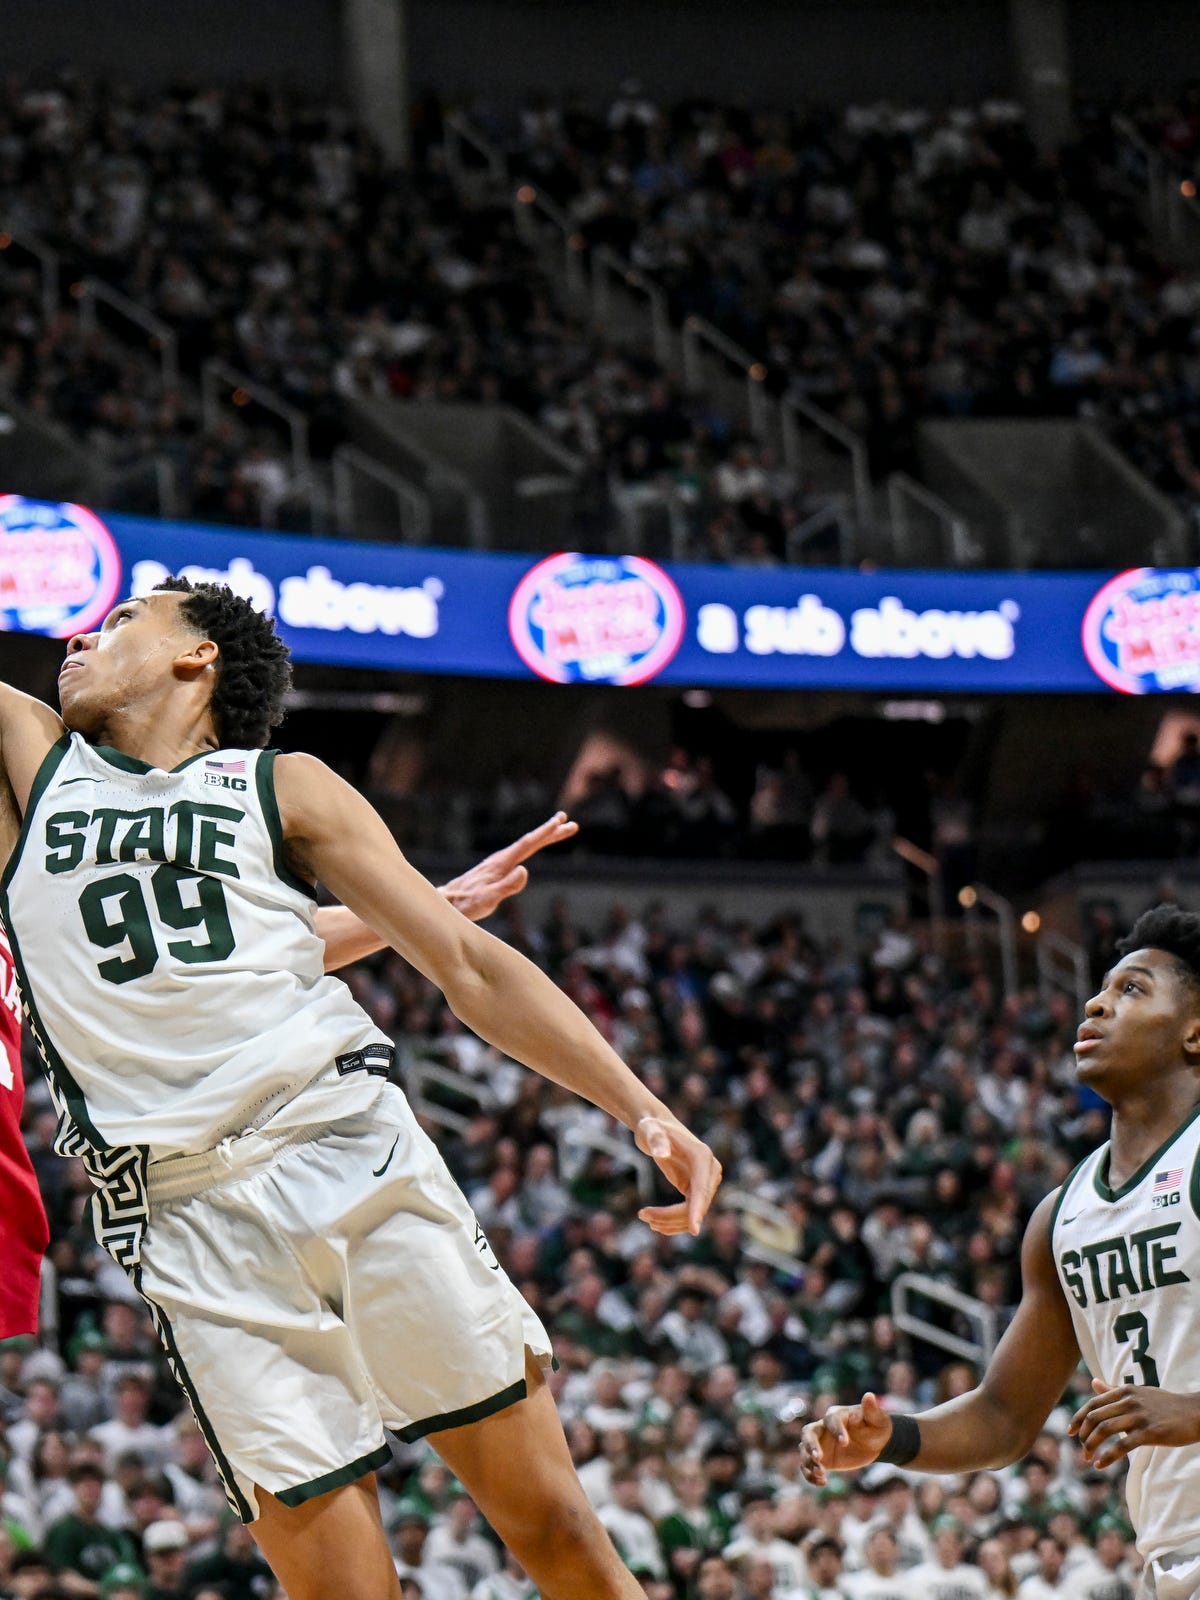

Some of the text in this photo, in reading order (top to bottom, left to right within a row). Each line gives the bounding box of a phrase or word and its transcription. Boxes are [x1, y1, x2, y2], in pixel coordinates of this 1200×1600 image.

[45, 800, 246, 880] STATE
[78, 863, 236, 985] 99
[1060, 1221, 1191, 1309] STATE
[1112, 1310, 1160, 1388] 3
